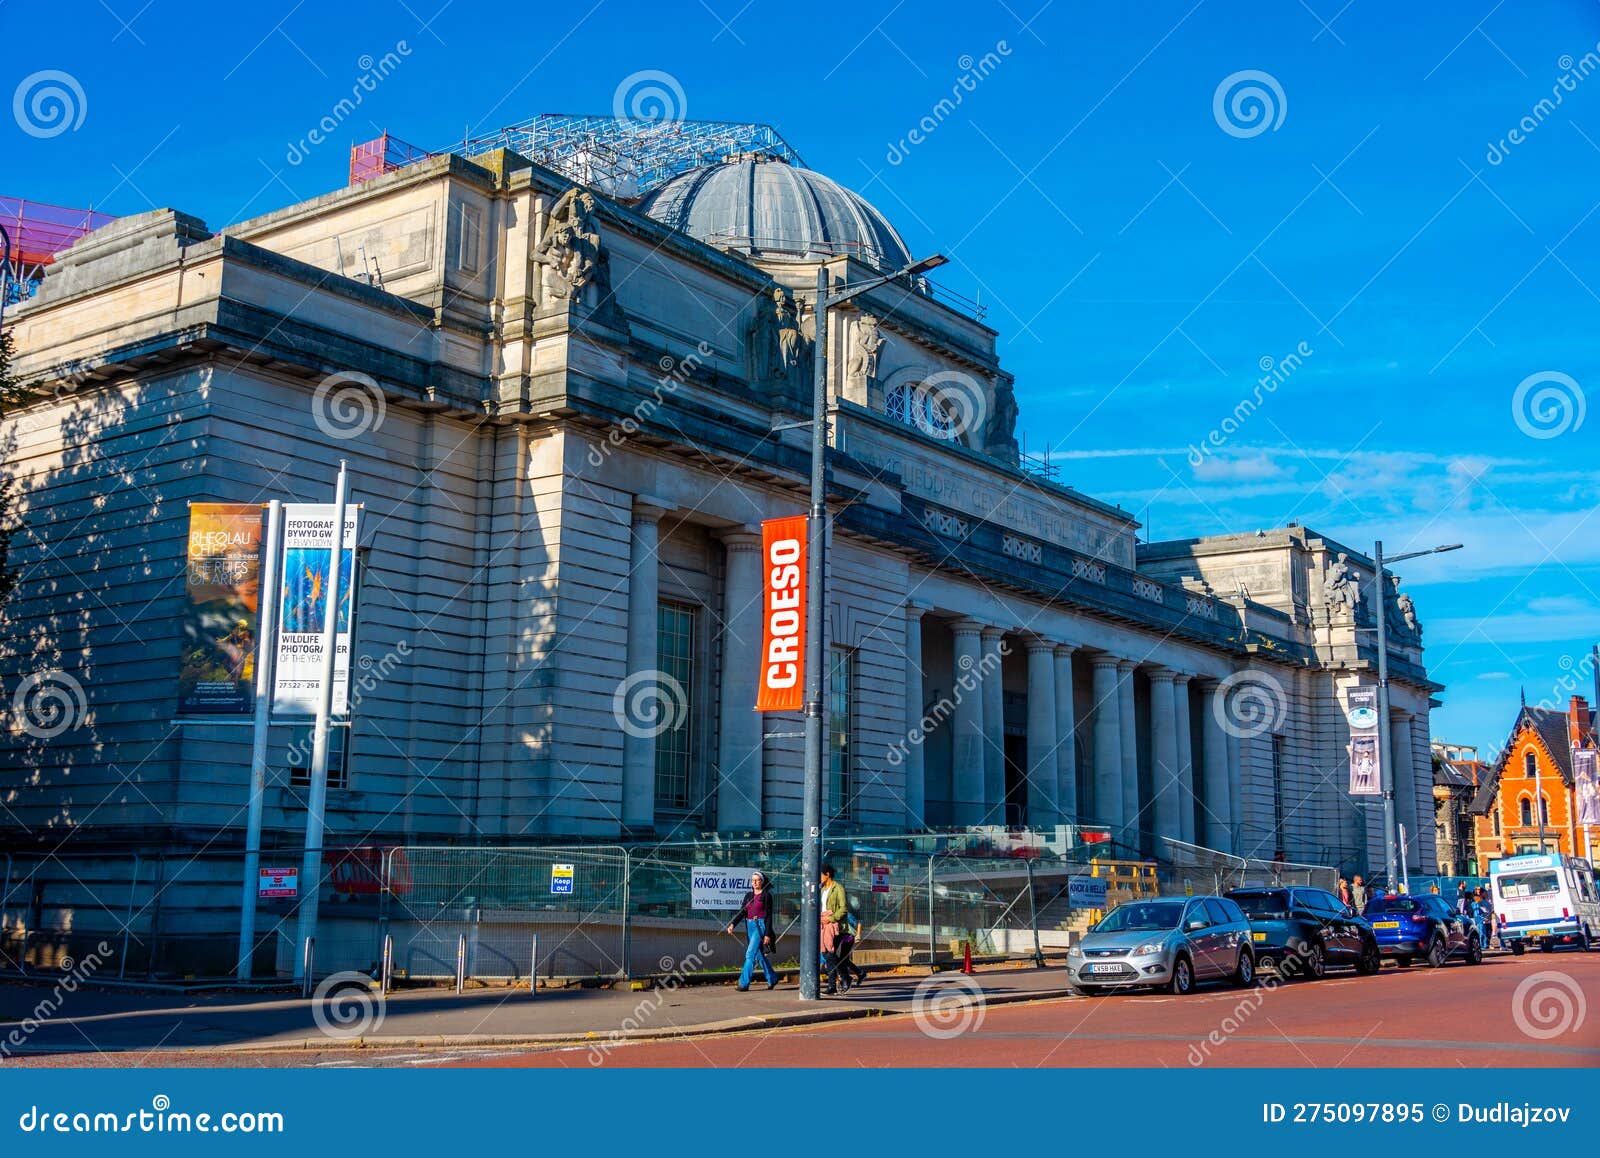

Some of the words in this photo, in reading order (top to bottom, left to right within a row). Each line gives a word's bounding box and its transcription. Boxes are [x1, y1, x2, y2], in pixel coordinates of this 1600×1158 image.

[287, 520, 355, 529] FFOTOGRAFDD
[287, 530, 318, 538] BYWYD
[191, 560, 212, 573] THE
[214, 560, 249, 574] RULES
[766, 538, 800, 689] CROESO
[281, 635, 320, 644] WILDLIFE
[280, 645, 348, 654] PHOTOGRER
[279, 654, 289, 663] OF
[291, 654, 306, 663] THE
[306, 654, 324, 663] YEA
[554, 878, 571, 886] Keep
[693, 877, 720, 889] KNOX
[720, 877, 728, 889] &
[728, 878, 752, 890] WELL
